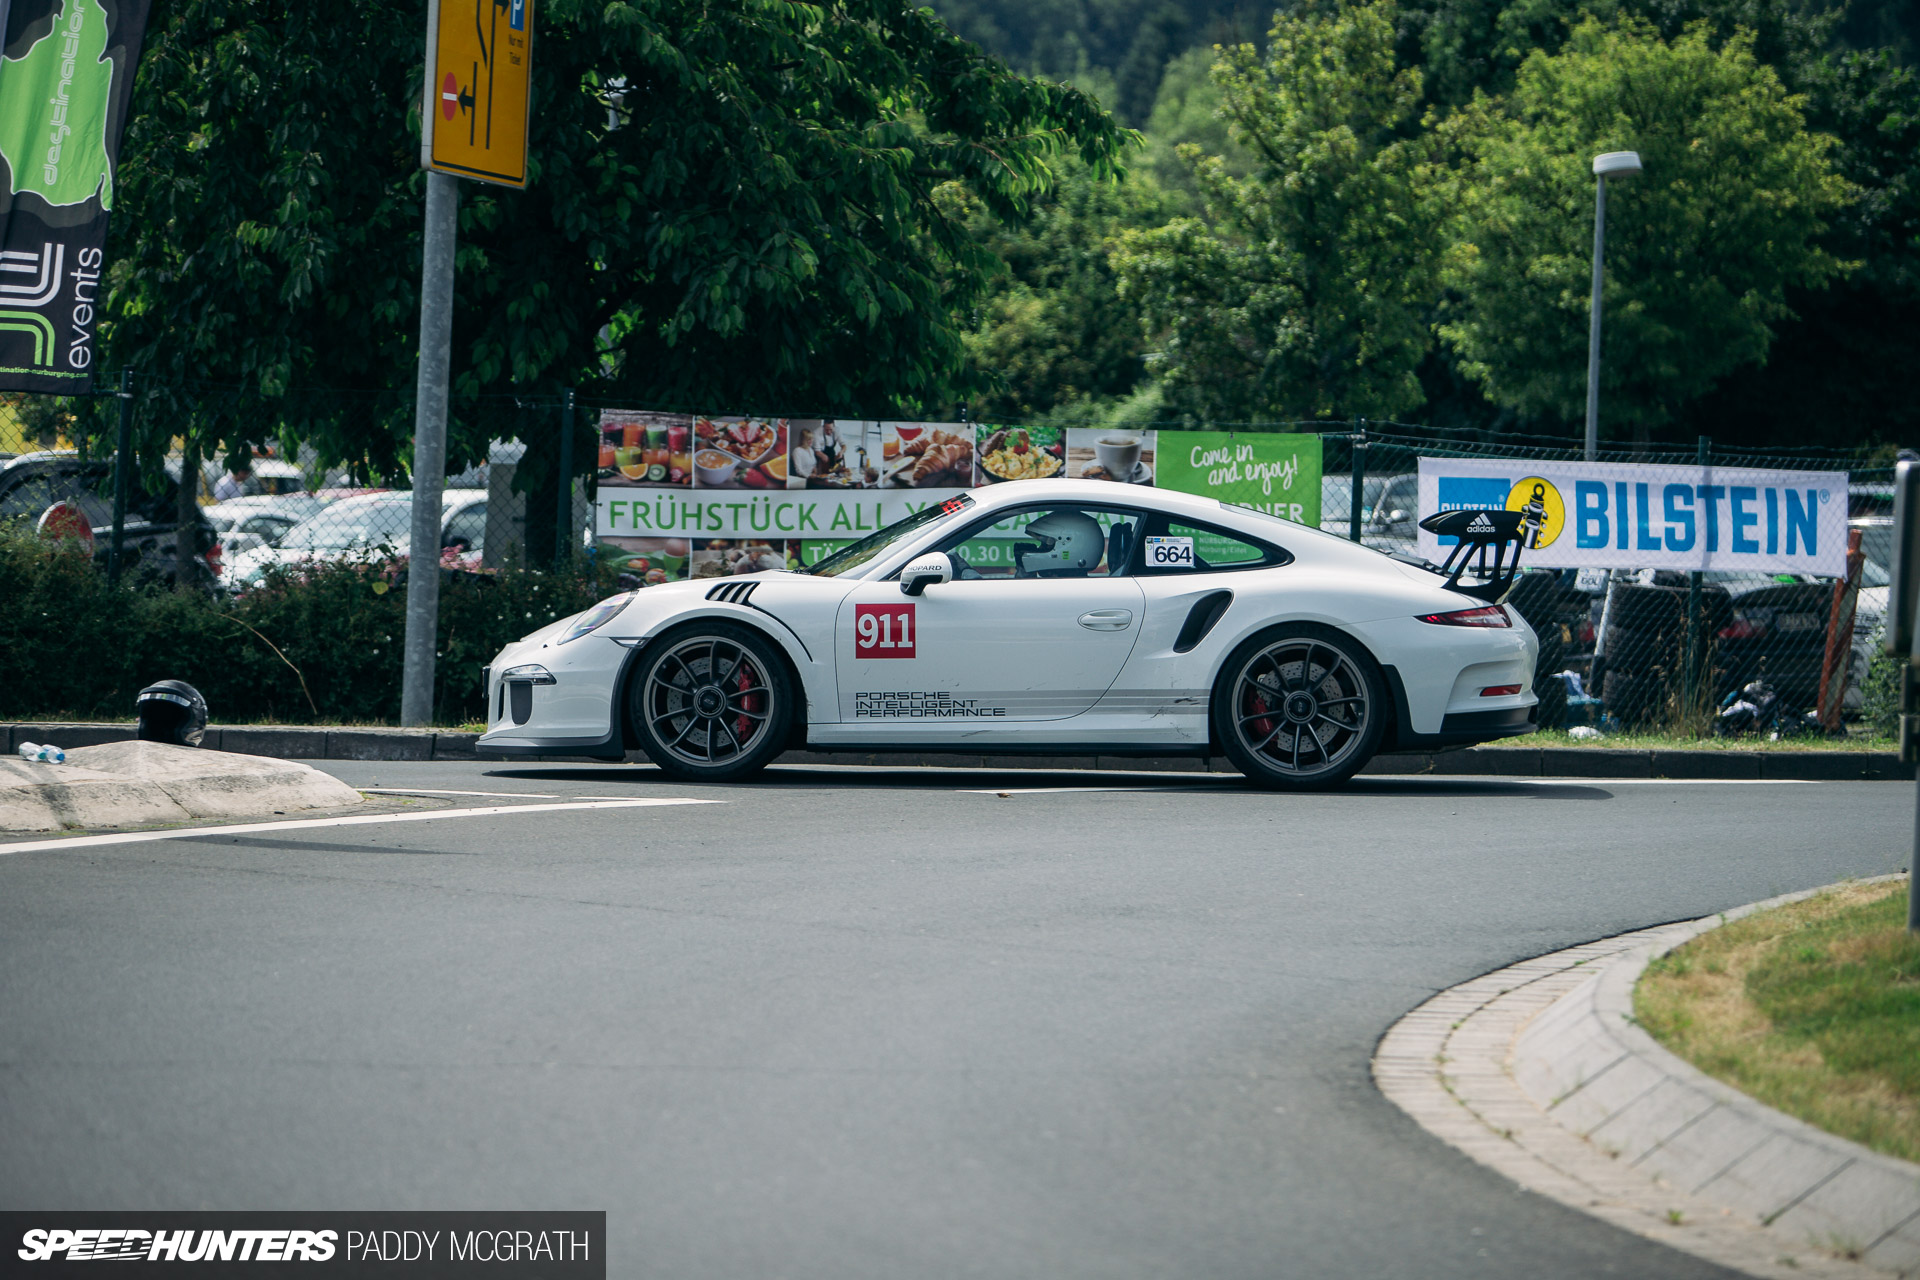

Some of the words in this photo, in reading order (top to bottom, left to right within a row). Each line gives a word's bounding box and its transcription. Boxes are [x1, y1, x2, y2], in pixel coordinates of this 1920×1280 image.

[69, 248, 102, 368] events
[1190, 446, 1232, 468] Come
[1236, 444, 1253, 462] in
[1208, 461, 1242, 485] and
[1245, 454, 1298, 496] enjoy!
[609, 494, 820, 532] FRÜHSTÜCK
[829, 502, 888, 531] ALL
[1153, 545, 1192, 563] 664
[857, 613, 914, 649] 911
[855, 692, 951, 701] PORSCHE
[855, 700, 978, 709] INTELLIGENT
[855, 708, 1006, 718] PERFORMANCE
